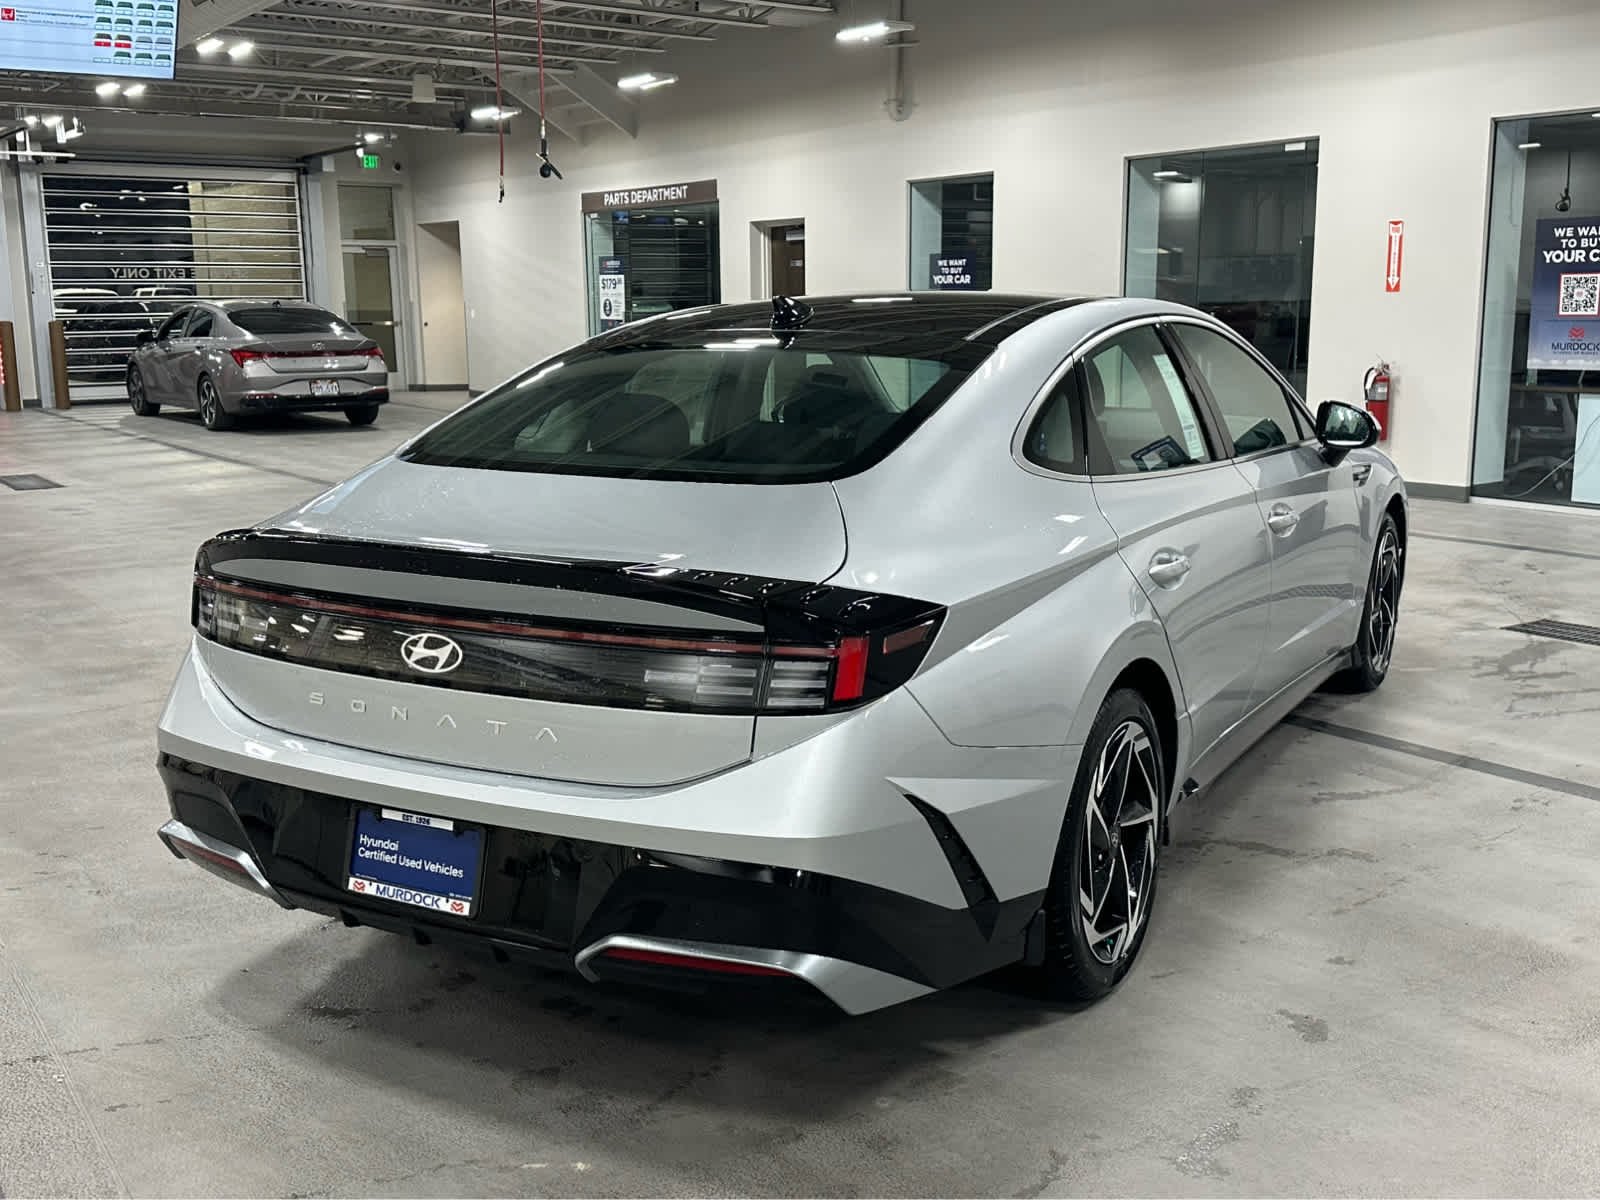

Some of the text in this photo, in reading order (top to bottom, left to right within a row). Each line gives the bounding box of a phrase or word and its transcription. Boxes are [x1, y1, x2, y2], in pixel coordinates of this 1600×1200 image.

[364, 155, 378, 168] EXIT
[604, 185, 688, 206] PARTS DEPARTMENT
[1554, 227, 1574, 237] WE
[1560, 237, 1600, 248] TO BU
[949, 258, 967, 266] WANT
[1542, 249, 1586, 263] YOUR
[933, 274, 971, 285] YOUR CAR
[1551, 342, 1600, 351] MURDOCK
[309, 691, 558, 744] SONATA
[360, 833, 399, 851] Hyundai
[358, 847, 464, 878] Certified Used Vehicles
[376, 884, 440, 908] MURDOCK
